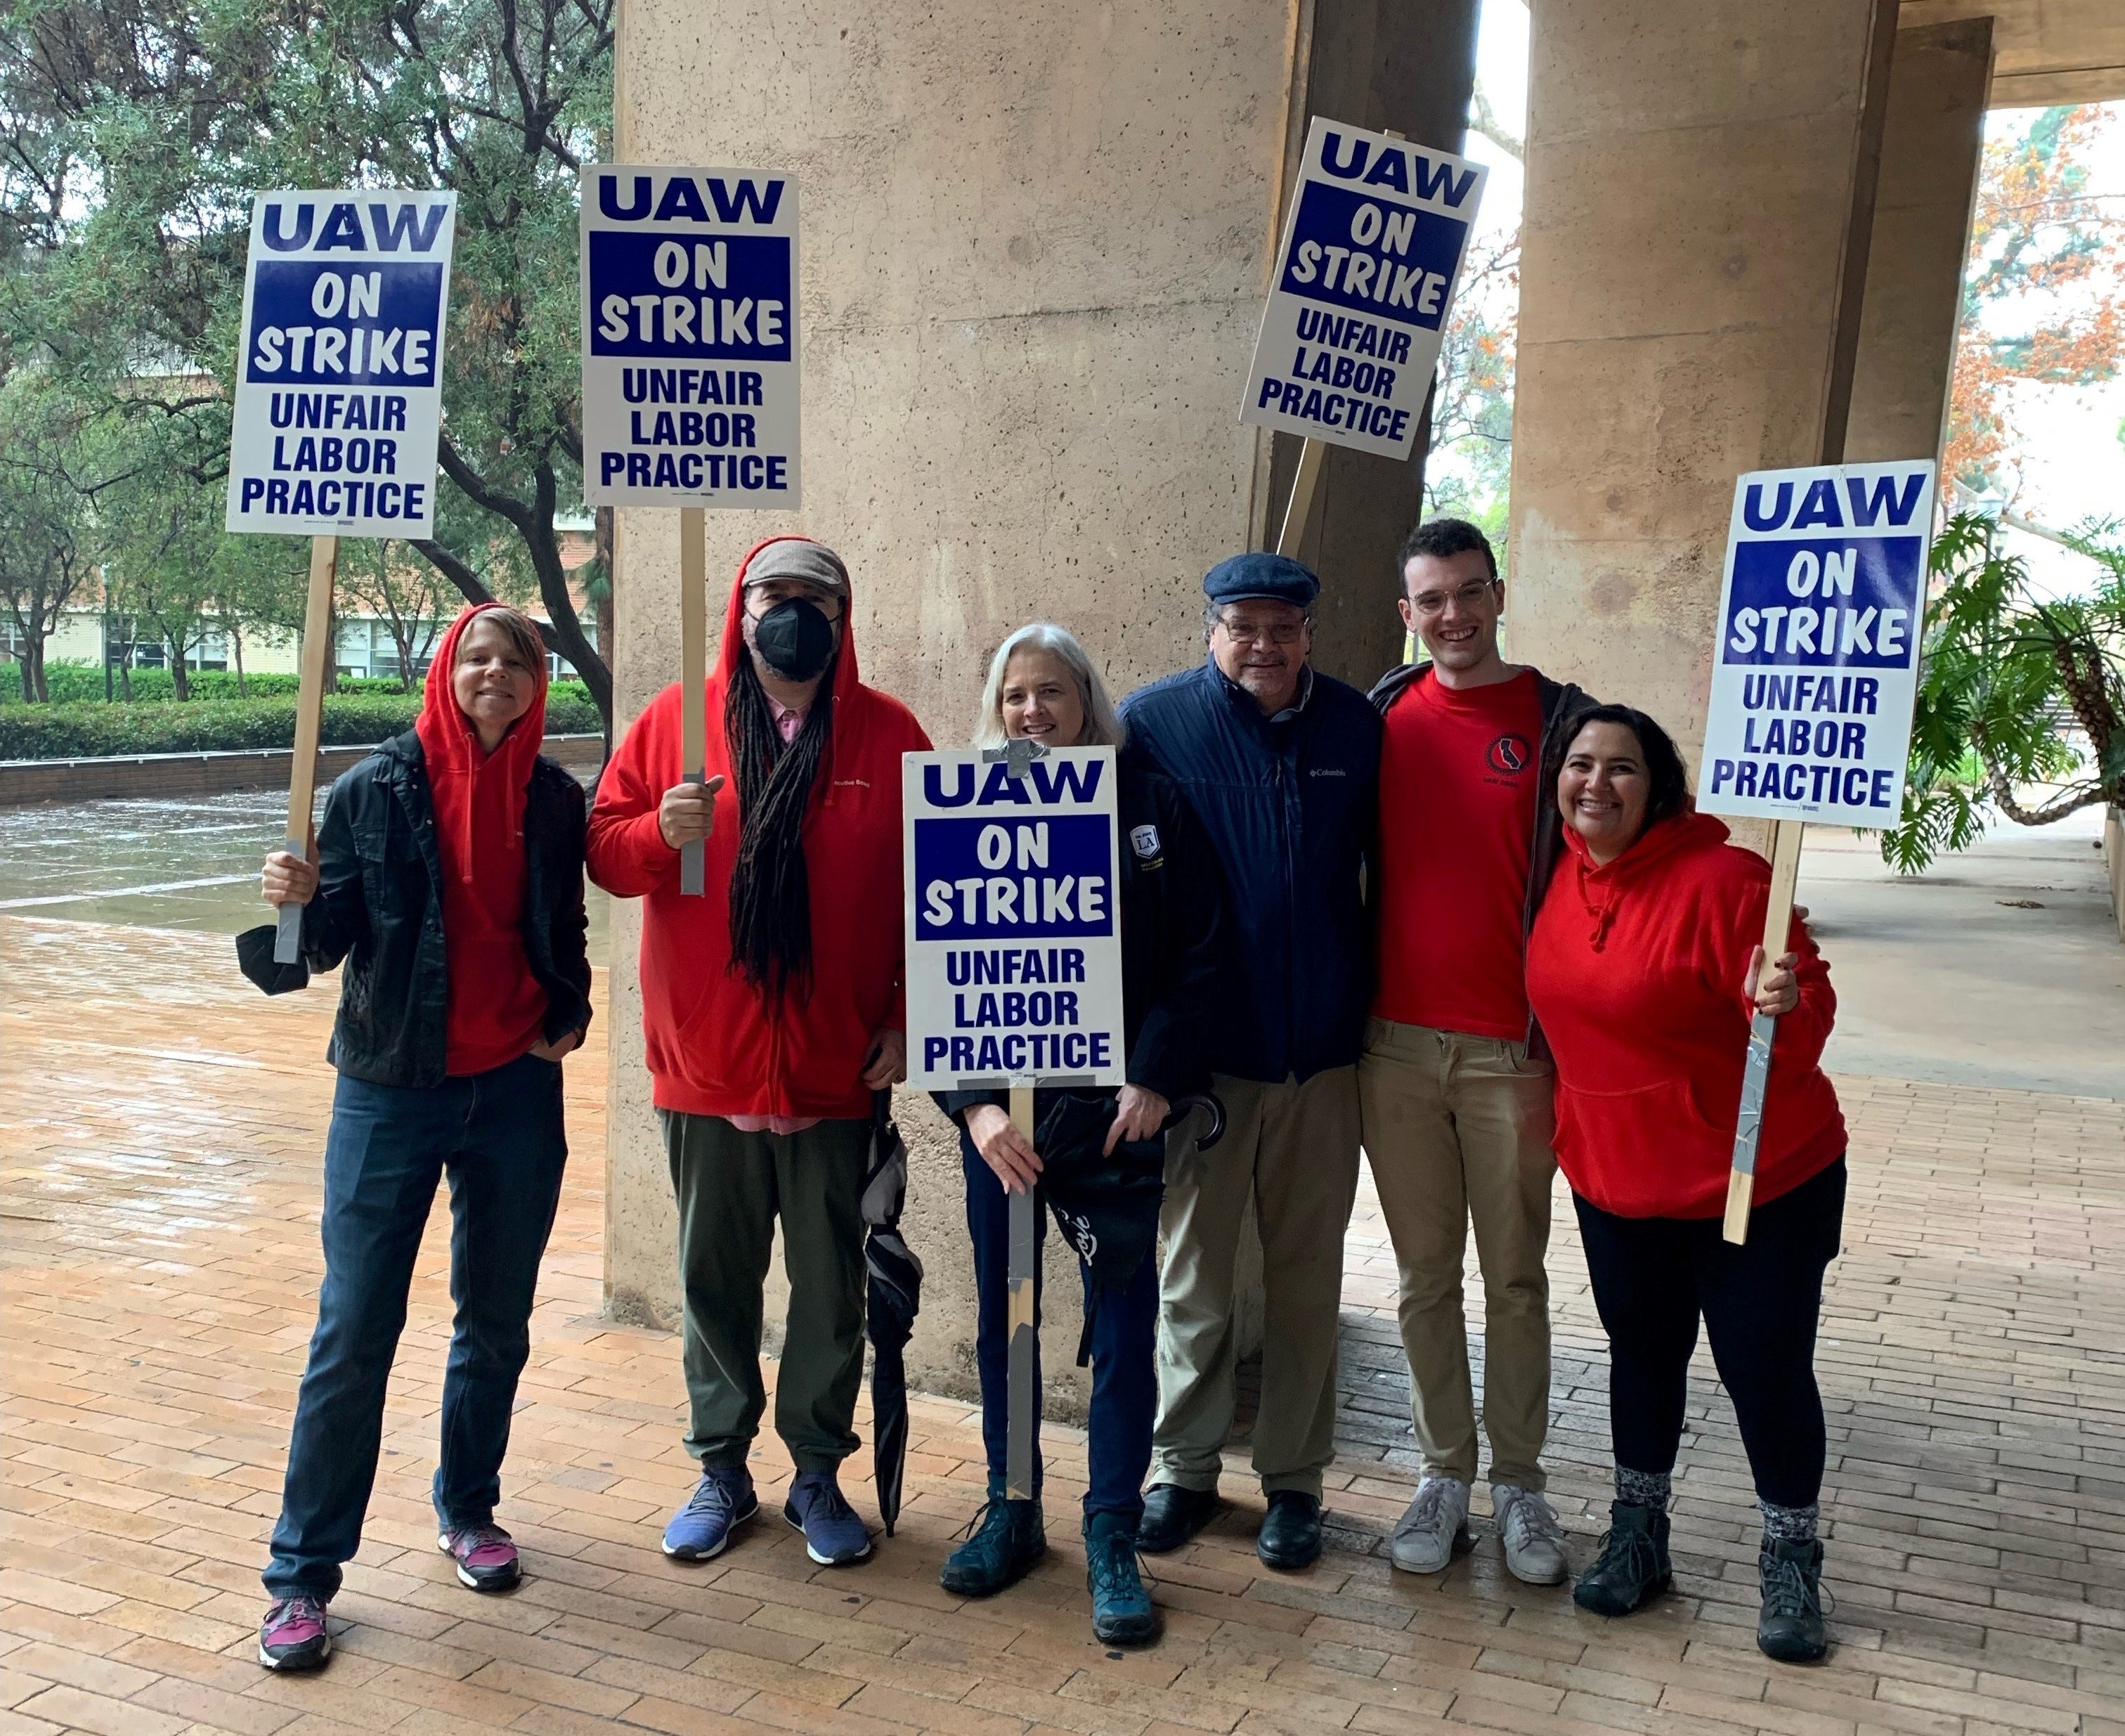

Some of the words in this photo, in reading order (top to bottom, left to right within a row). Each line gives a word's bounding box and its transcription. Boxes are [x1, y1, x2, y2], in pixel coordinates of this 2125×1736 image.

[1321, 131, 1477, 208] UAW
[599, 176, 784, 224] UAW
[263, 204, 448, 252] UAW
[1351, 203, 1416, 256] ON
[654, 241, 727, 290] ON
[1292, 240, 1445, 314] STRIKE
[312, 272, 382, 318] ON
[599, 294, 784, 346] STRIKE
[1297, 308, 1411, 364] UNFAIR
[254, 326, 430, 375] STRIKE
[1292, 346, 1396, 399] LABOR
[623, 368, 762, 406] UNFAIR
[1258, 378, 1410, 441] PRACTICE
[271, 393, 406, 431] UNFAIR
[632, 411, 755, 447] LABOR
[273, 436, 396, 474] LABOR
[602, 453, 787, 489] PRACTICE
[241, 478, 424, 519] PRACTICE
[1744, 474, 1927, 531] UAW
[1787, 548, 1857, 597] ON
[1730, 607, 1907, 656] STRIKE
[1743, 675, 1878, 714] UNFAIR
[1744, 718, 1866, 760] LABOR
[924, 760, 1104, 808] UAW
[1711, 760, 1894, 808] PRACTICE
[977, 822, 1048, 870] ON
[1137, 837, 1155, 850] LA
[923, 875, 1105, 926] STRIKE
[947, 949, 1085, 985] UNFAIR
[955, 991, 1078, 1028] LABOR
[925, 1032, 1110, 1072] PRACTICE
